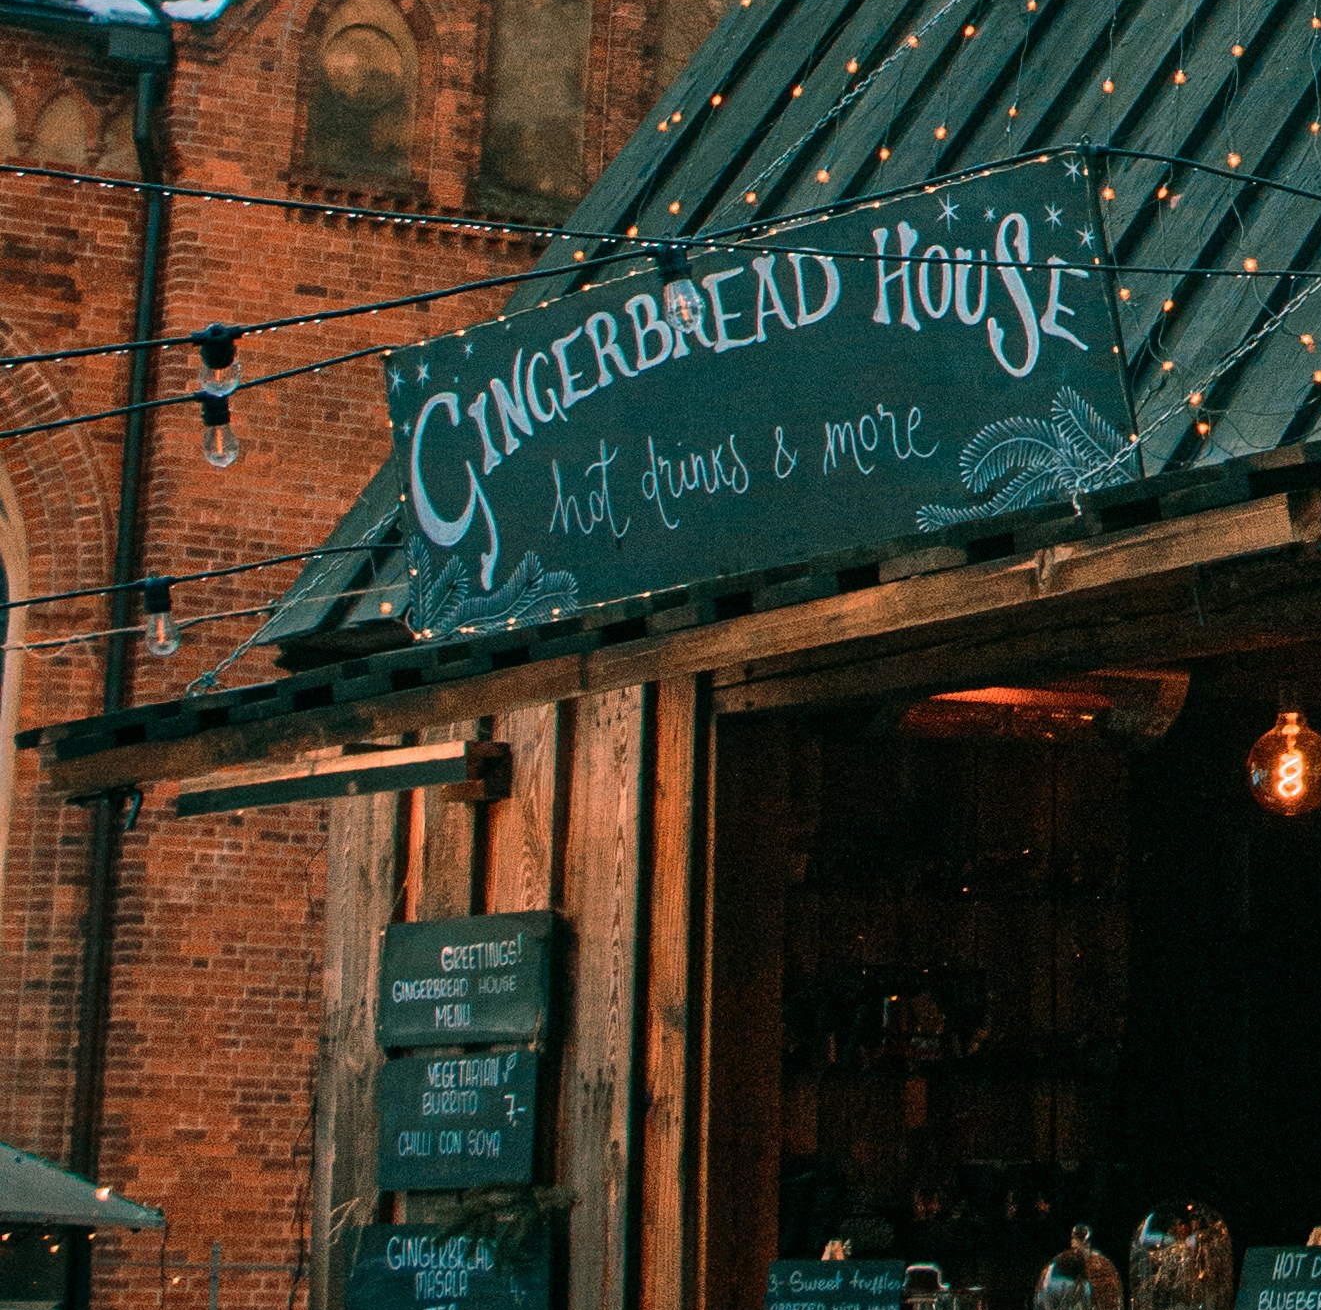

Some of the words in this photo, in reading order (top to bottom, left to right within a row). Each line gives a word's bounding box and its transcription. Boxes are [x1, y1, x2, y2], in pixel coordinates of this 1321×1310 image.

[873, 213, 1089, 378] HOUSE
[549, 440, 630, 538] hot
[642, 433, 748, 530] drinks
[774, 427, 798, 480] &
[823, 403, 940, 475] more
[441, 933, 523, 972] GREETINGS!
[392, 977, 468, 1003] GINGERBREAD
[479, 975, 517, 994] HOUSE
[435, 1004, 472, 1028] MENU
[427, 1057, 500, 1088] VEGETARIAN
[422, 1091, 478, 1116] BURRITO
[399, 1130, 431, 1156] CHILLI
[439, 1130, 461, 1155] CON
[468, 1129, 500, 1158] SOYA
[1272, 1251, 1308, 1280] HOT
[415, 1270, 468, 1300] MASALA
[790, 1270, 843, 1292] Sweet
